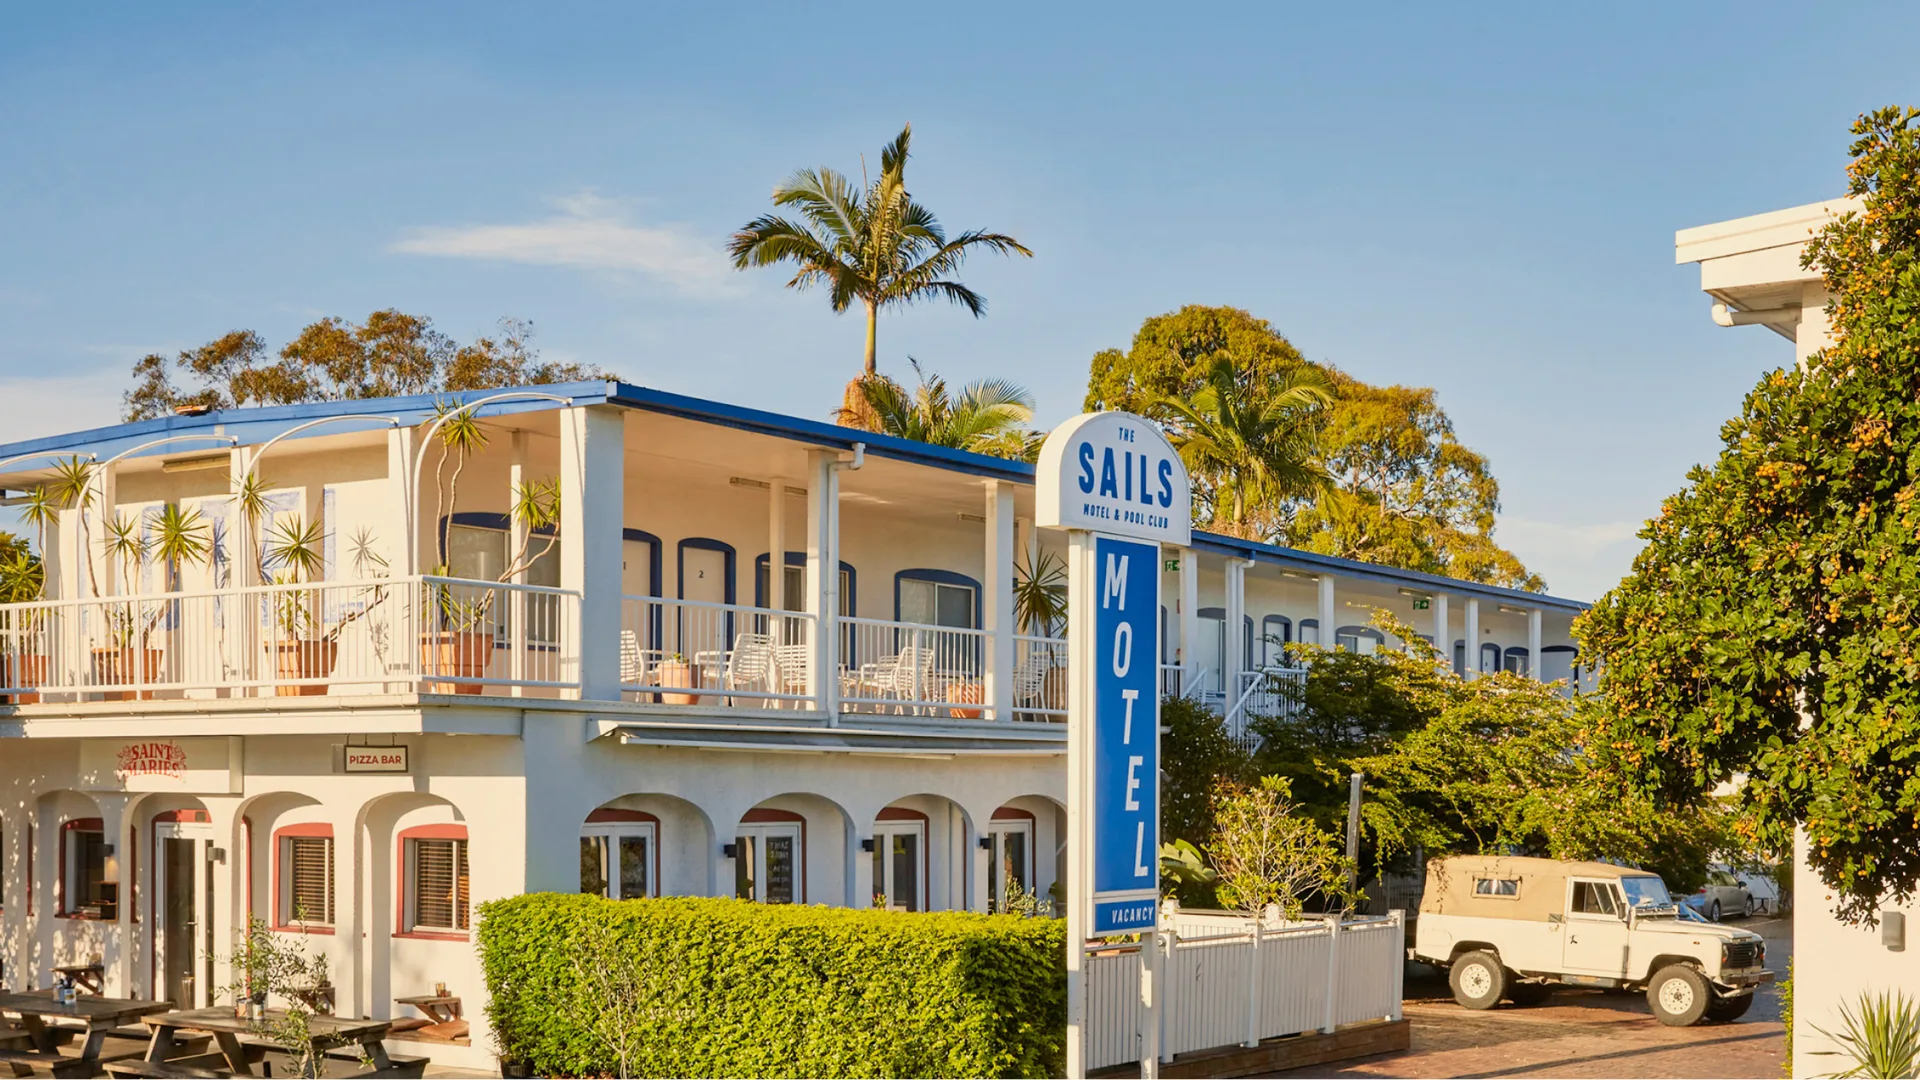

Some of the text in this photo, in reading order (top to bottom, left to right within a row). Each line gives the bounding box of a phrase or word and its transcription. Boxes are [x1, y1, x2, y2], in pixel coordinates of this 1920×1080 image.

[1119, 427, 1135, 443] THE
[1079, 442, 1172, 508] SAILS
[1083, 503, 1169, 529] MOTEL & POOL CLUB
[698, 570, 704, 578] 2
[1103, 553, 1149, 877] MOTEL
[131, 743, 172, 760] SAINT
[349, 755, 402, 765] PIZZA BAR
[125, 760, 179, 778] MARIES
[1112, 906, 1154, 923] VACANCY
